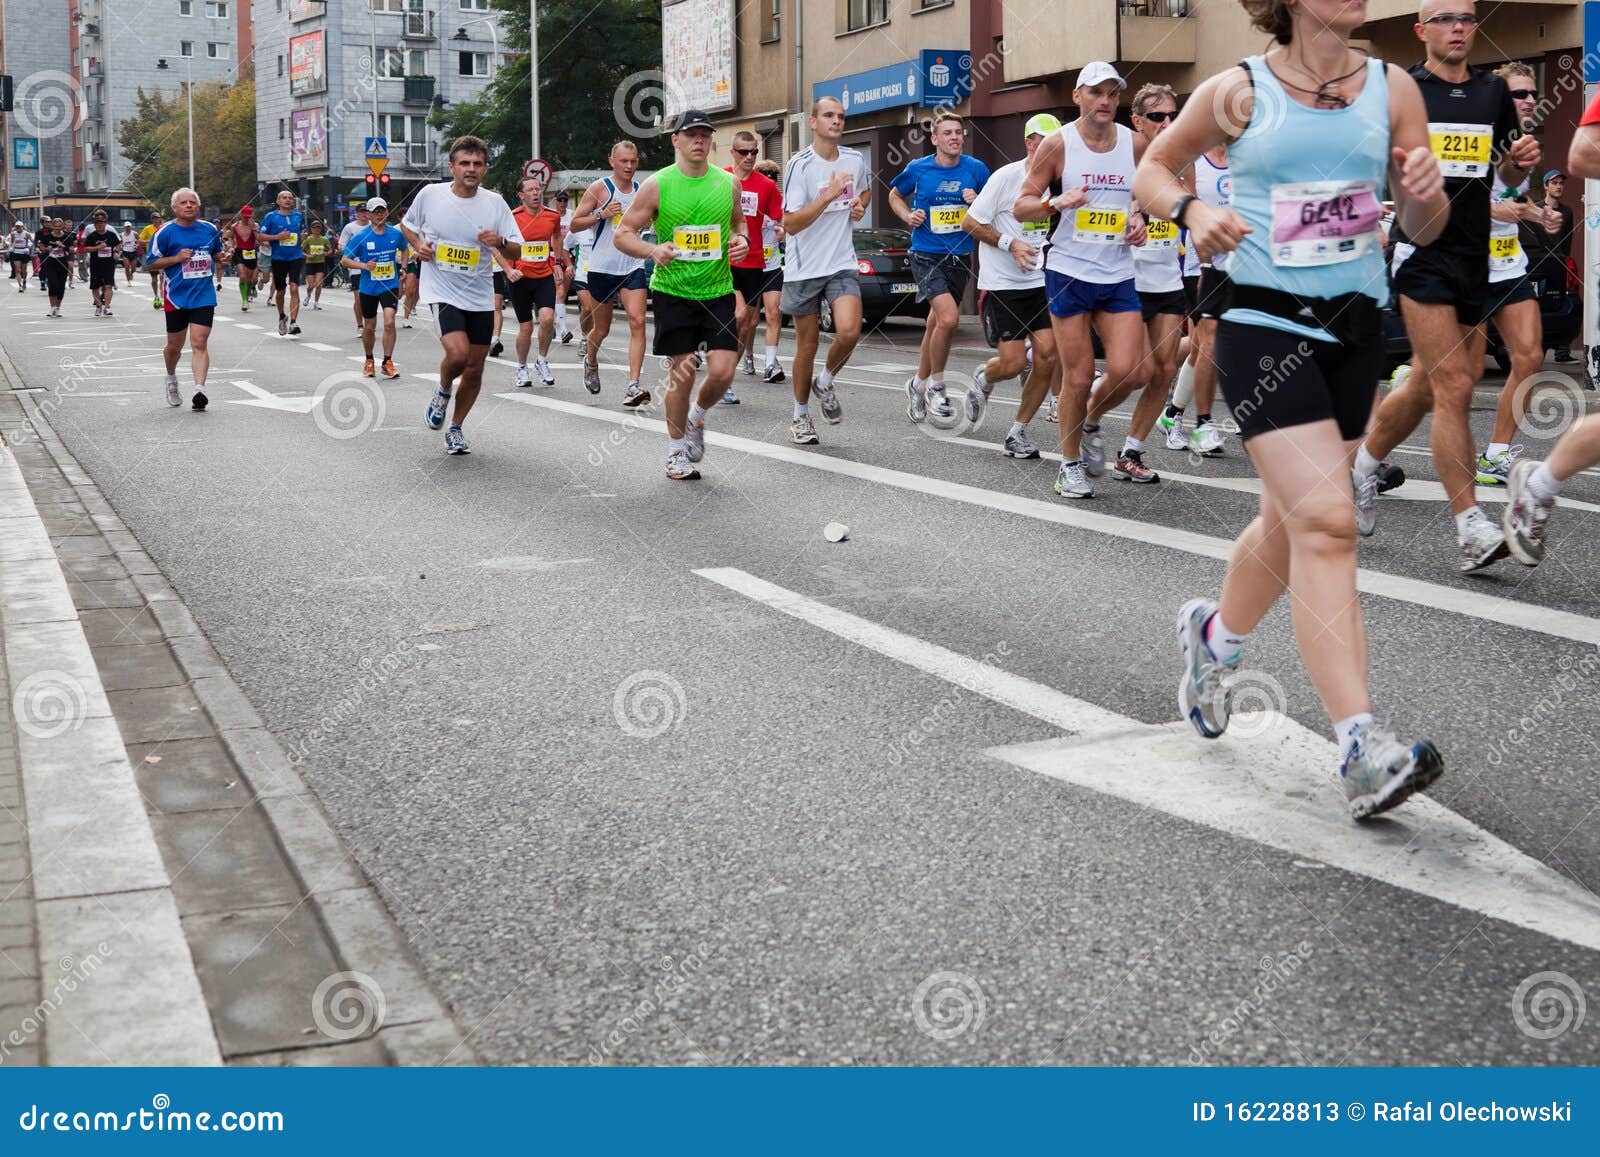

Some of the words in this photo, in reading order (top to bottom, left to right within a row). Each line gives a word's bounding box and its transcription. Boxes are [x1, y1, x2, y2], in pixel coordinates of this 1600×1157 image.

[854, 92, 865, 105] PKO
[865, 88, 881, 102] BANK
[881, 82, 902, 98] POLSKI
[1443, 135, 1479, 152] 2214
[1082, 174, 1125, 185] TIMEX
[939, 211, 960, 221] 2274
[1301, 195, 1359, 226] 6242
[1089, 212, 1117, 226] 2716
[1149, 221, 1170, 233] 2457
[686, 233, 710, 245] 2116
[447, 247, 471, 260] 2105
